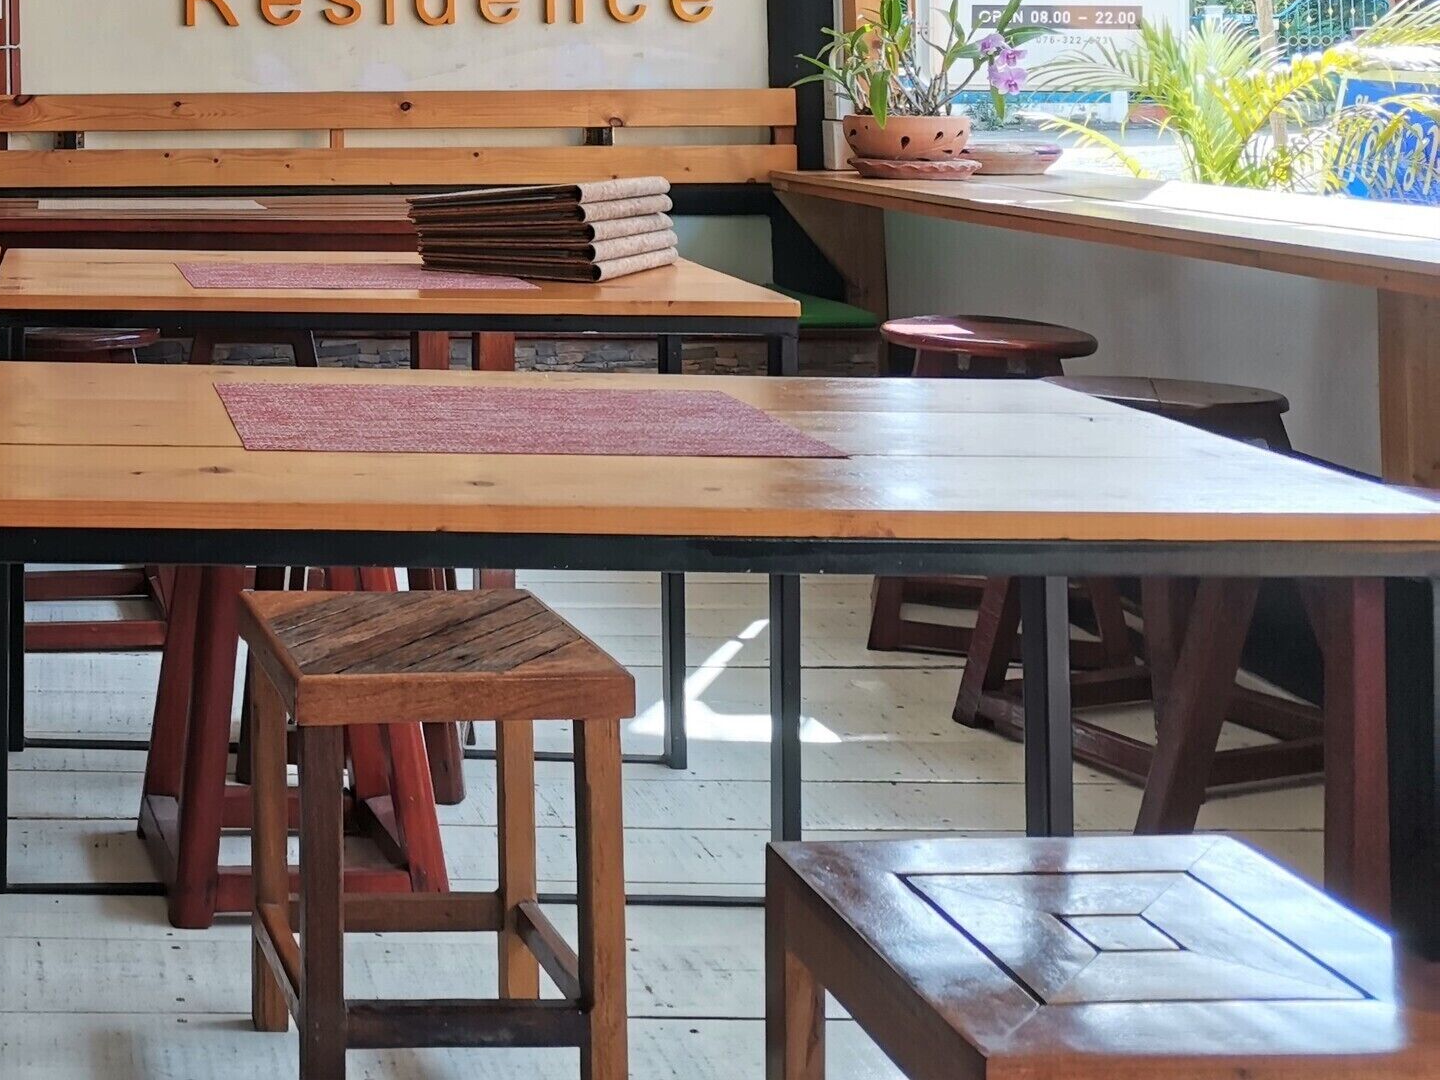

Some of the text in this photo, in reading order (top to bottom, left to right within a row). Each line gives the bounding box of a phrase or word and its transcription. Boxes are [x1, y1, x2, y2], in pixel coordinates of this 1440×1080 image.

[978, 9, 1024, 24] OPN
[1030, 10, 1071, 24] 08.00
[1095, 11, 1136, 24] 22.00
